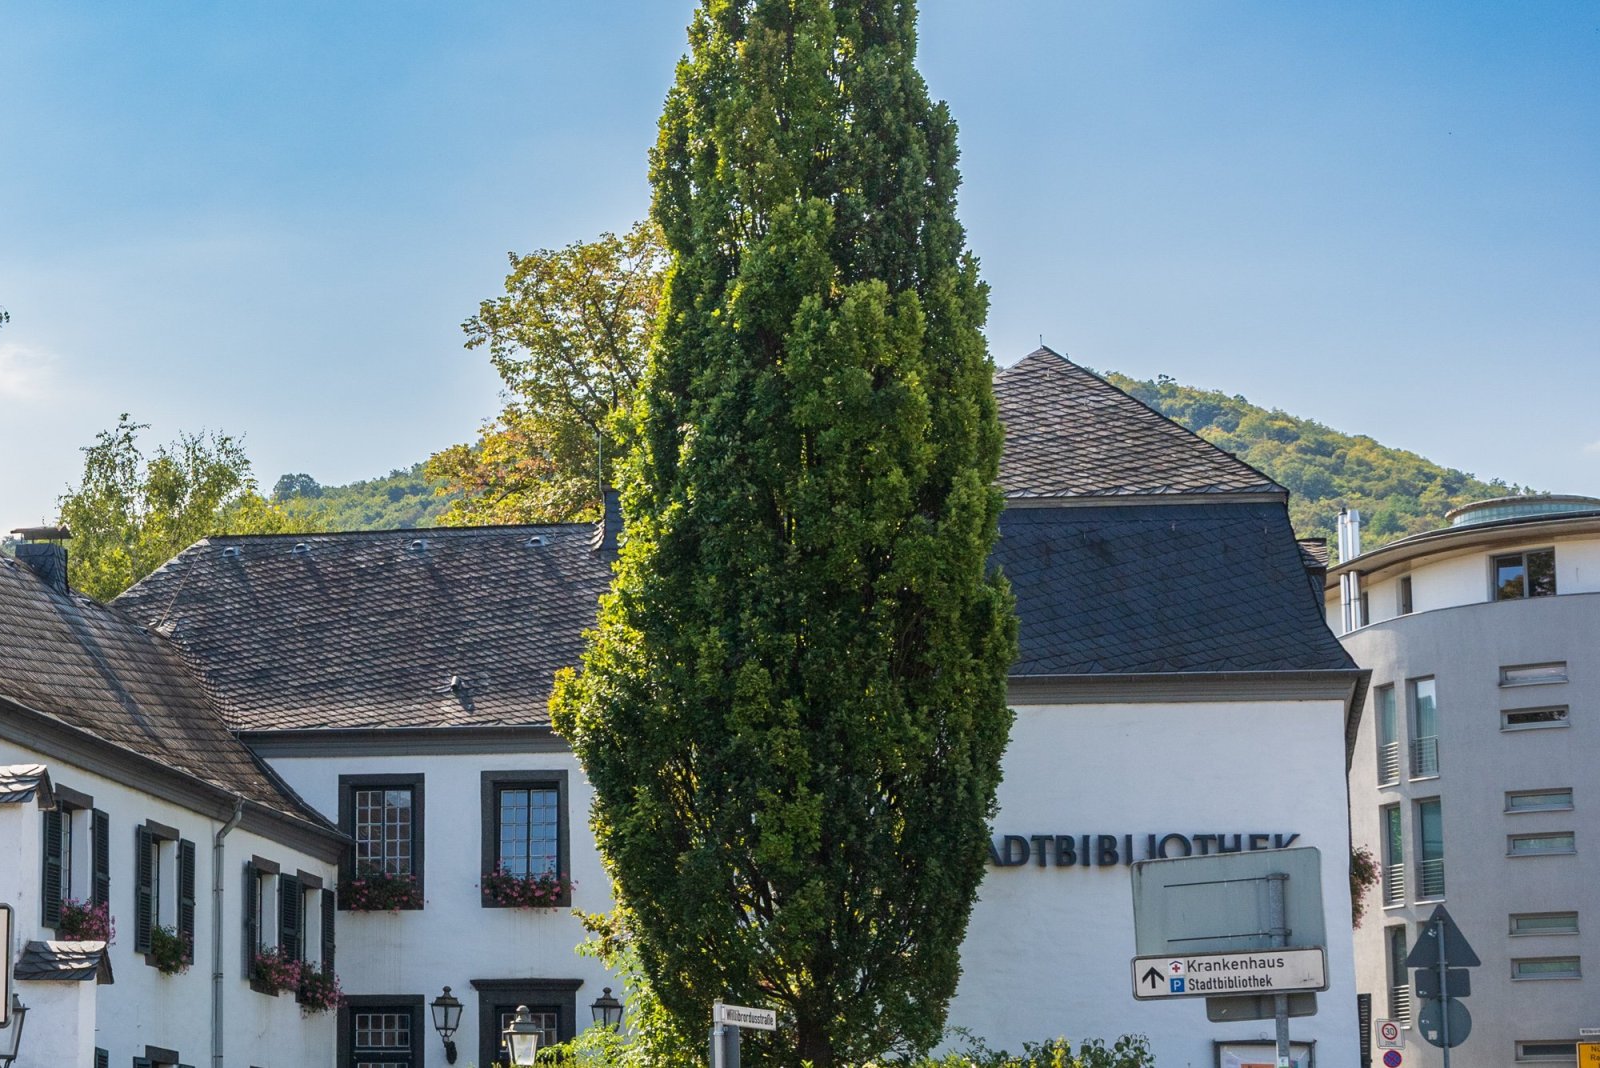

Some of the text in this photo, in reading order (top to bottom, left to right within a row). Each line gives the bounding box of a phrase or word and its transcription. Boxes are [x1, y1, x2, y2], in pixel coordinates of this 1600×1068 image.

[1186, 955, 1285, 973] Krankenhaus
[1188, 974, 1273, 992] Stadtbibliothek
[1385, 1027, 1395, 1036] 30
